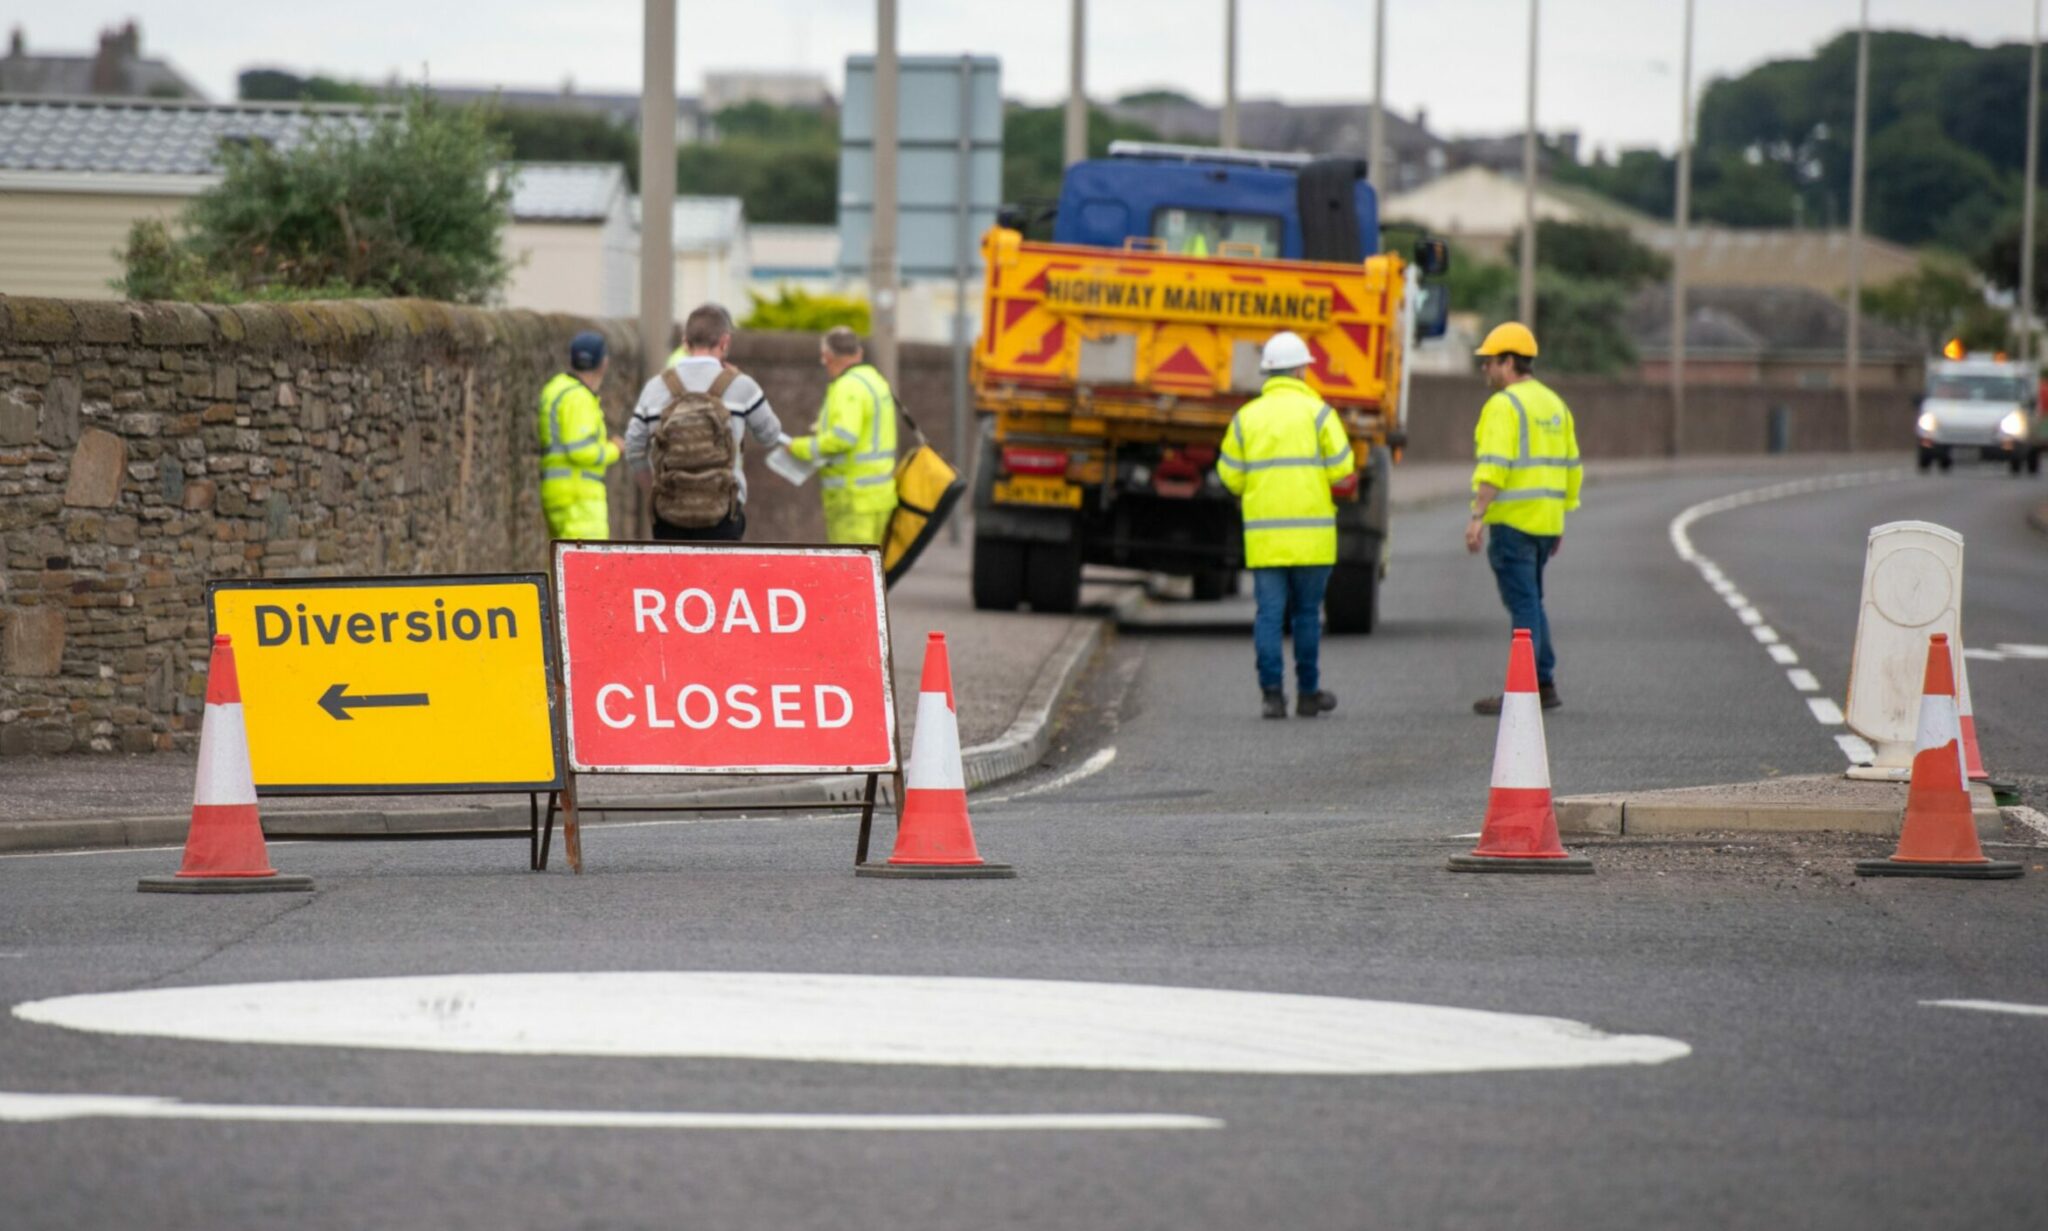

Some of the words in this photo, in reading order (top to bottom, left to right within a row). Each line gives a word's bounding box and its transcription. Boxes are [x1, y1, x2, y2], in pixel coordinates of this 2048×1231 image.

[1046, 279, 1154, 308] HIGHWAY
[1164, 286, 1332, 321] MAINTENANCE
[255, 599, 518, 647] Diversion
[632, 588, 808, 634] ROAD
[595, 684, 854, 729] CLOSED
